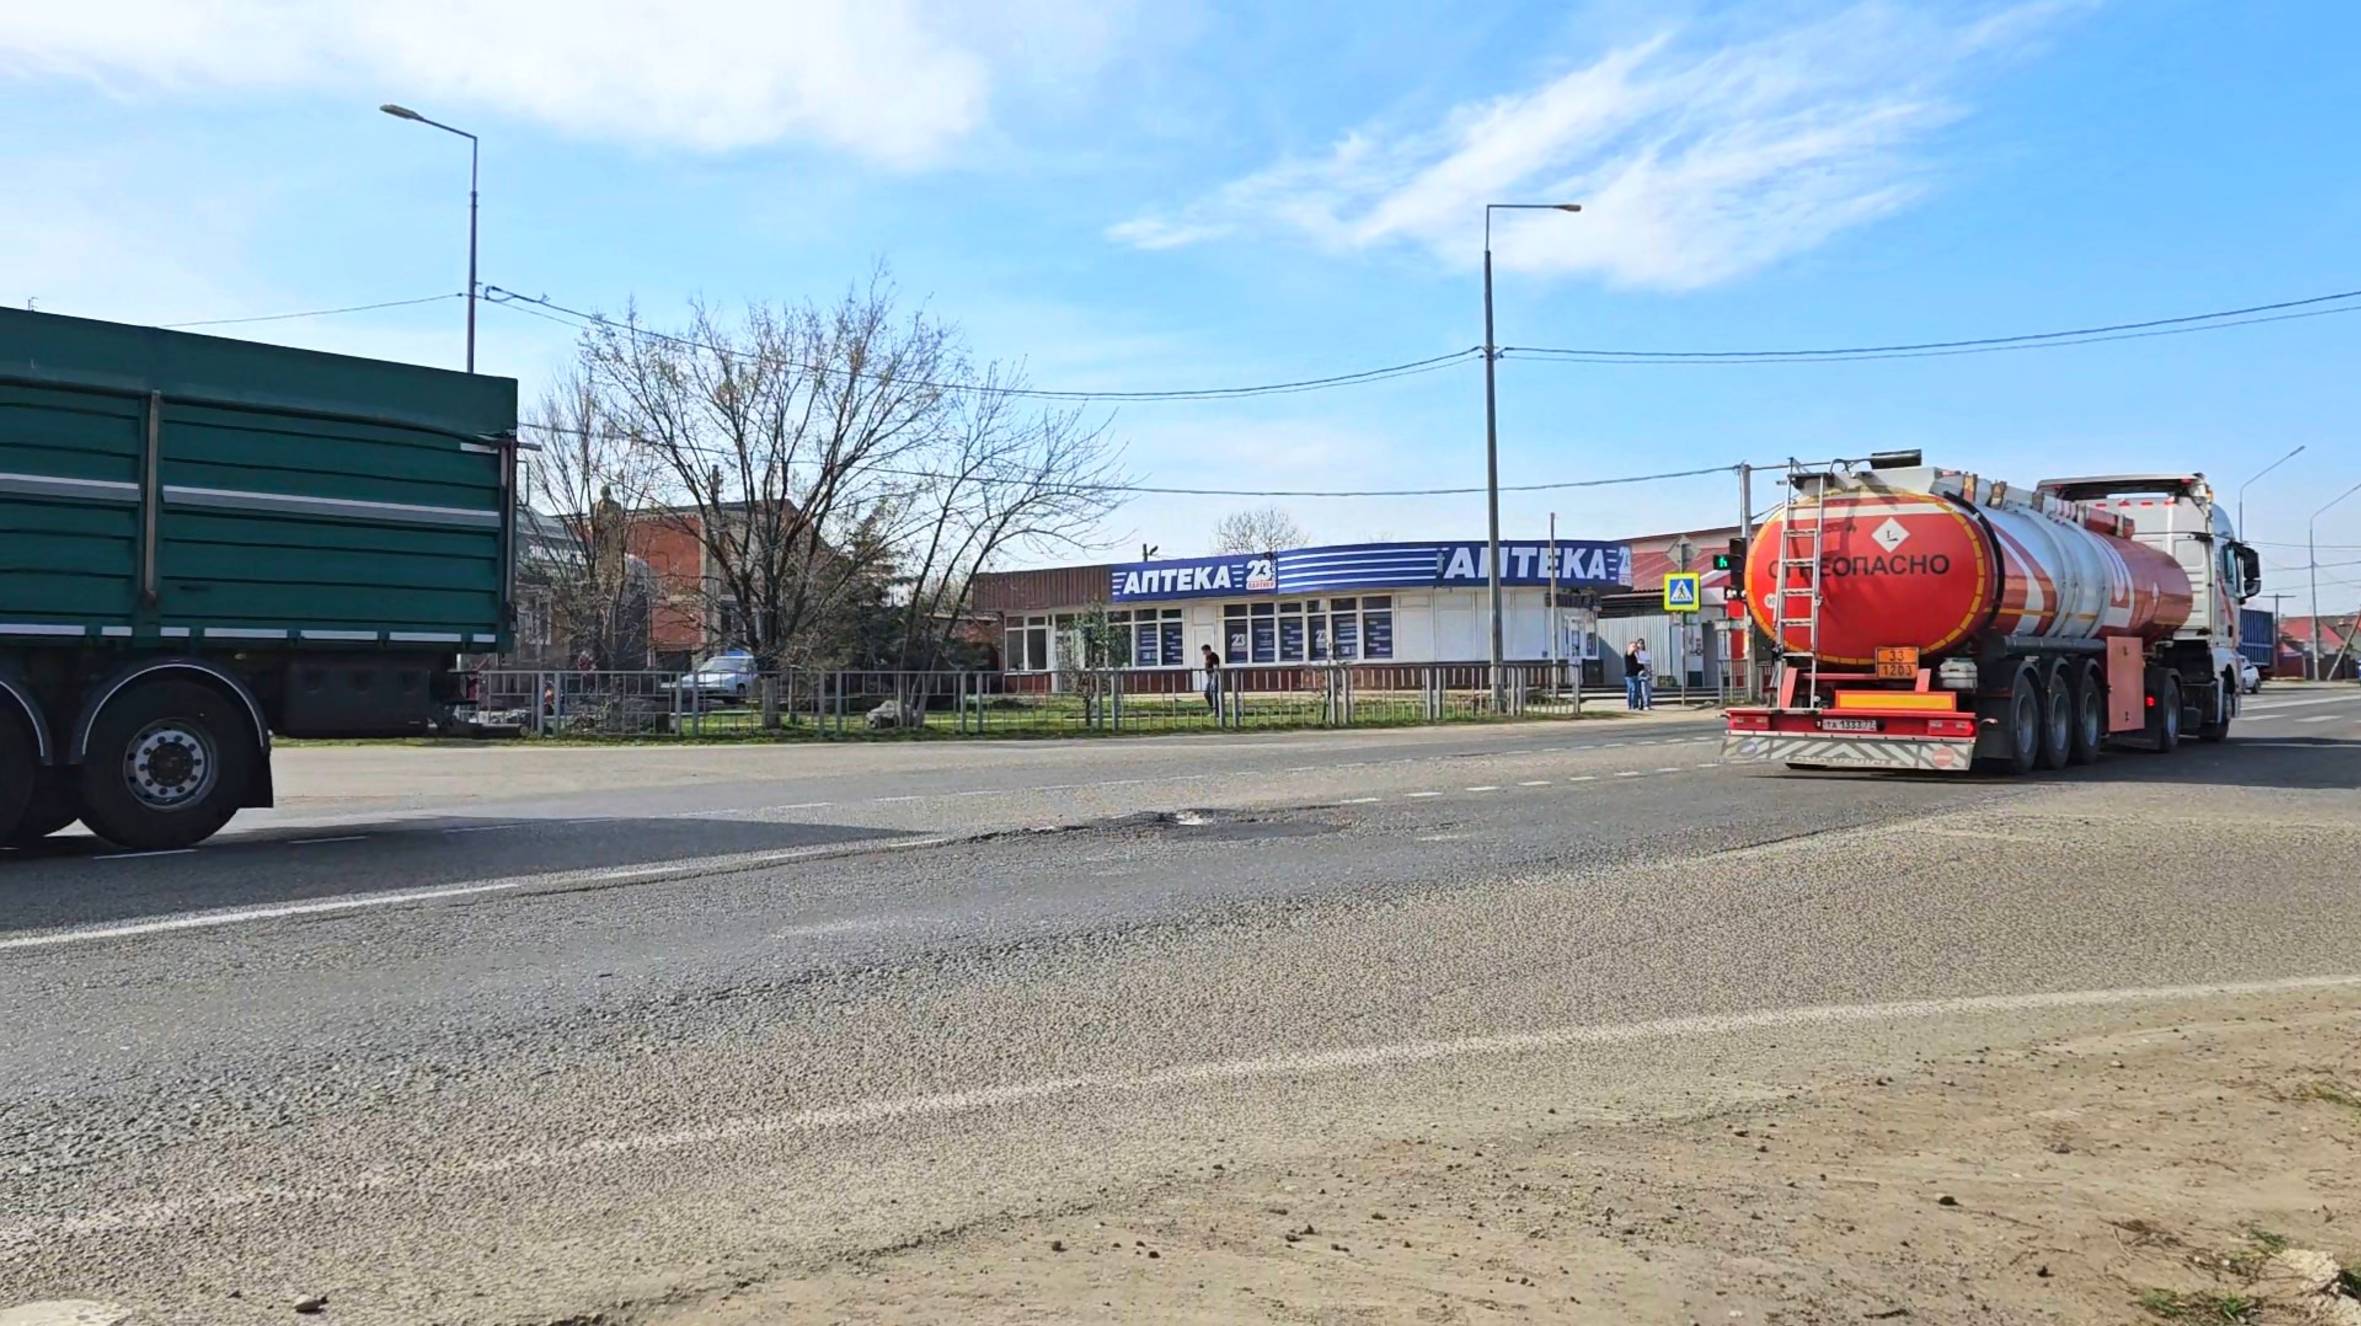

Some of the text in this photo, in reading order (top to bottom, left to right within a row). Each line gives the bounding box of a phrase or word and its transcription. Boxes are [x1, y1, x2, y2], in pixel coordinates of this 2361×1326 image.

[1246, 559, 1273, 582] 23
[1442, 547, 1607, 580] АПТЕКА
[1122, 565, 1231, 595] АПТЕКА
[1889, 650, 1905, 662] 33
[1883, 665, 1913, 677] 1203
